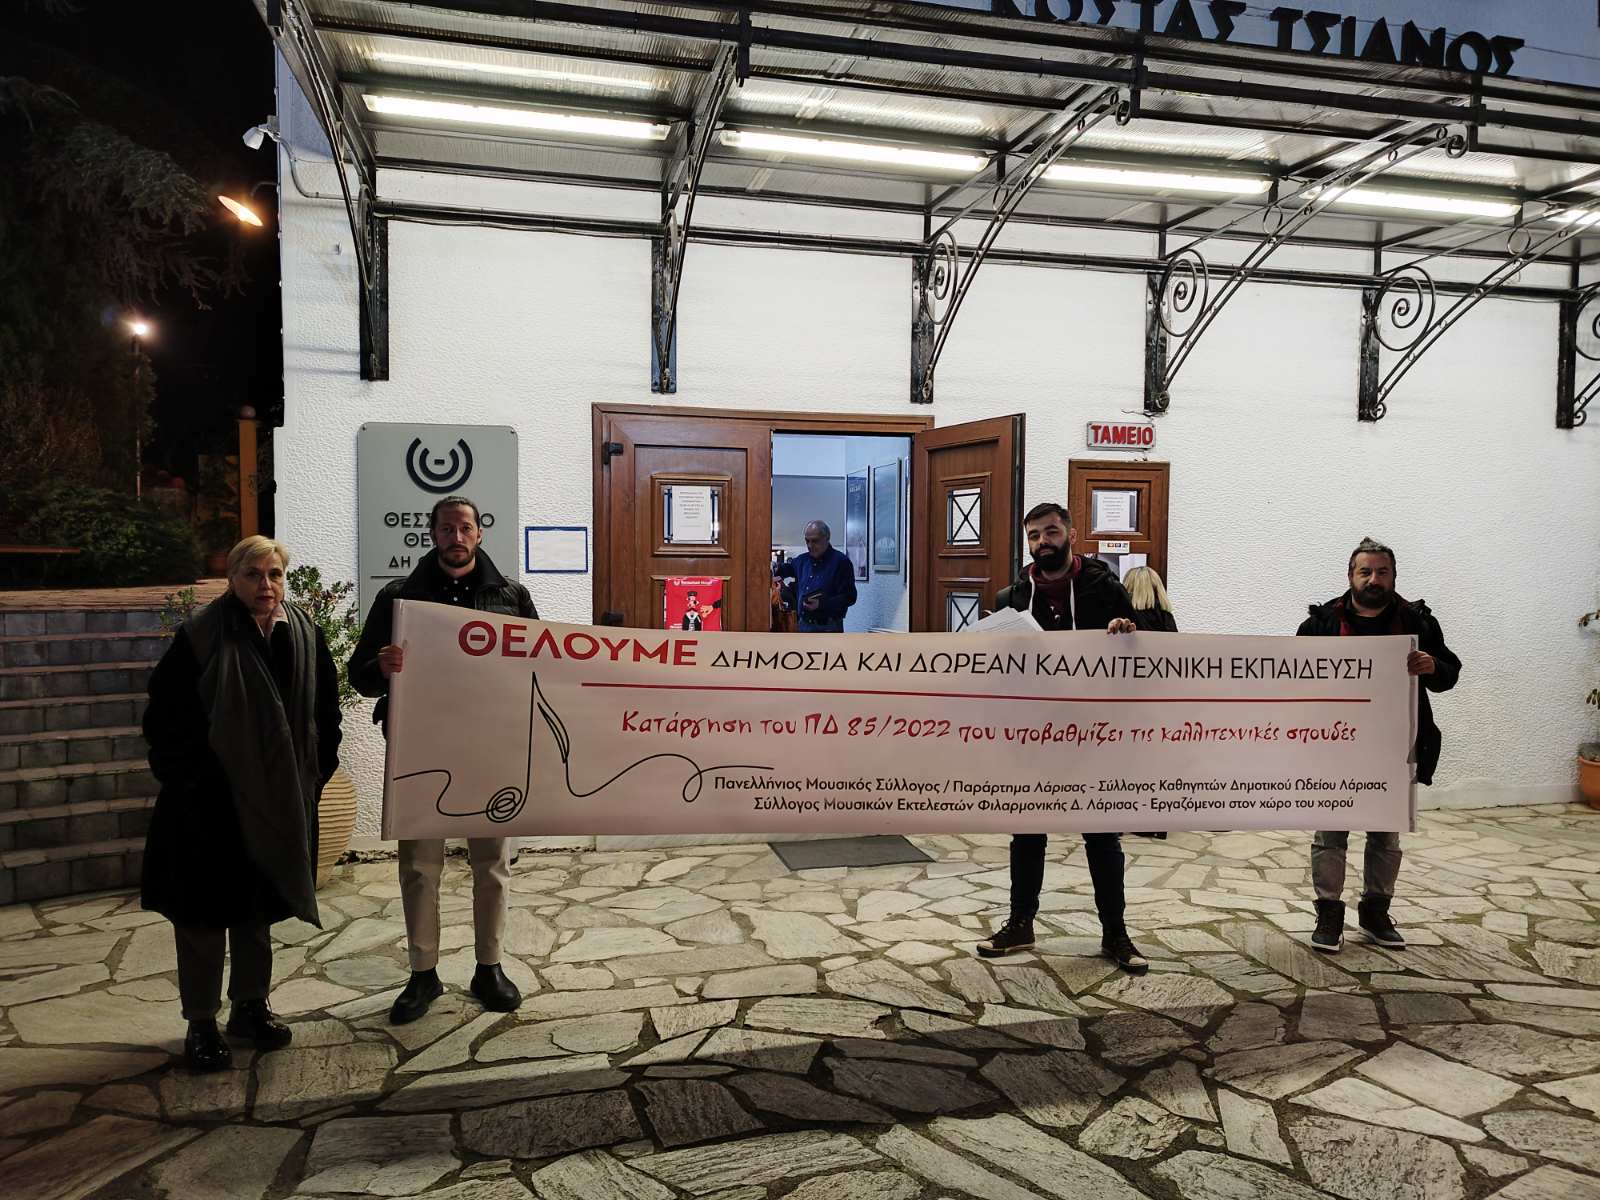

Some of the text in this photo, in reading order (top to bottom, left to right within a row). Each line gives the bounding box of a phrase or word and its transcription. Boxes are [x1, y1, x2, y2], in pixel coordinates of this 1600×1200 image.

[1270, 7, 1525, 76] ΤΣΙΑΝΟΣ
[1091, 425, 1153, 445] ΤΑΜΕΙΟ
[384, 512, 495, 529] ΘΕΣΣΟ
[458, 620, 1373, 680] ΘΕΛΟΥΜΕ ΔΗΜΟΣΙΑ ΚΑΙ ΔΩΡΕΑΝ ΚΑΛΛΙΤΕΧΝΙΚΗ ΕΚΠΑΙΔΕΥΣΗ
[622, 710, 1357, 747] Κατάργηση του ΠΔ 85/2022 που υποβαθμίζει τις καλλιτεχνικές σπουδές
[714, 776, 802, 791] Πανελλήνιος
[806, 777, 873, 792] Μουσικός
[876, 778, 940, 793] Σύλλογος
[953, 780, 1031, 795] Παράρτημα
[1034, 781, 1087, 795] Λάρισας
[1098, 780, 1155, 794] Σύλλογος
[1159, 778, 1227, 793] Καθηγητών
[1230, 778, 1292, 793] Δημοτικού
[1295, 778, 1337, 791] Ωδείου
[1339, 778, 1388, 792] Λάρισας
[753, 797, 819, 813] Σύλλογος
[824, 797, 893, 811] Μουσικών
[897, 797, 974, 811] Εκτελεστών
[978, 798, 1067, 814] Φιλαρμονικής
[1070, 799, 1083, 811] Δ.
[1086, 798, 1138, 812] Λάρισας
[1150, 797, 1225, 812] Εργαζόμενοι
[1229, 799, 1255, 809] στον
[1259, 796, 1291, 811] χώρο
[1294, 799, 1315, 809] του
[1318, 796, 1354, 811] χορού
